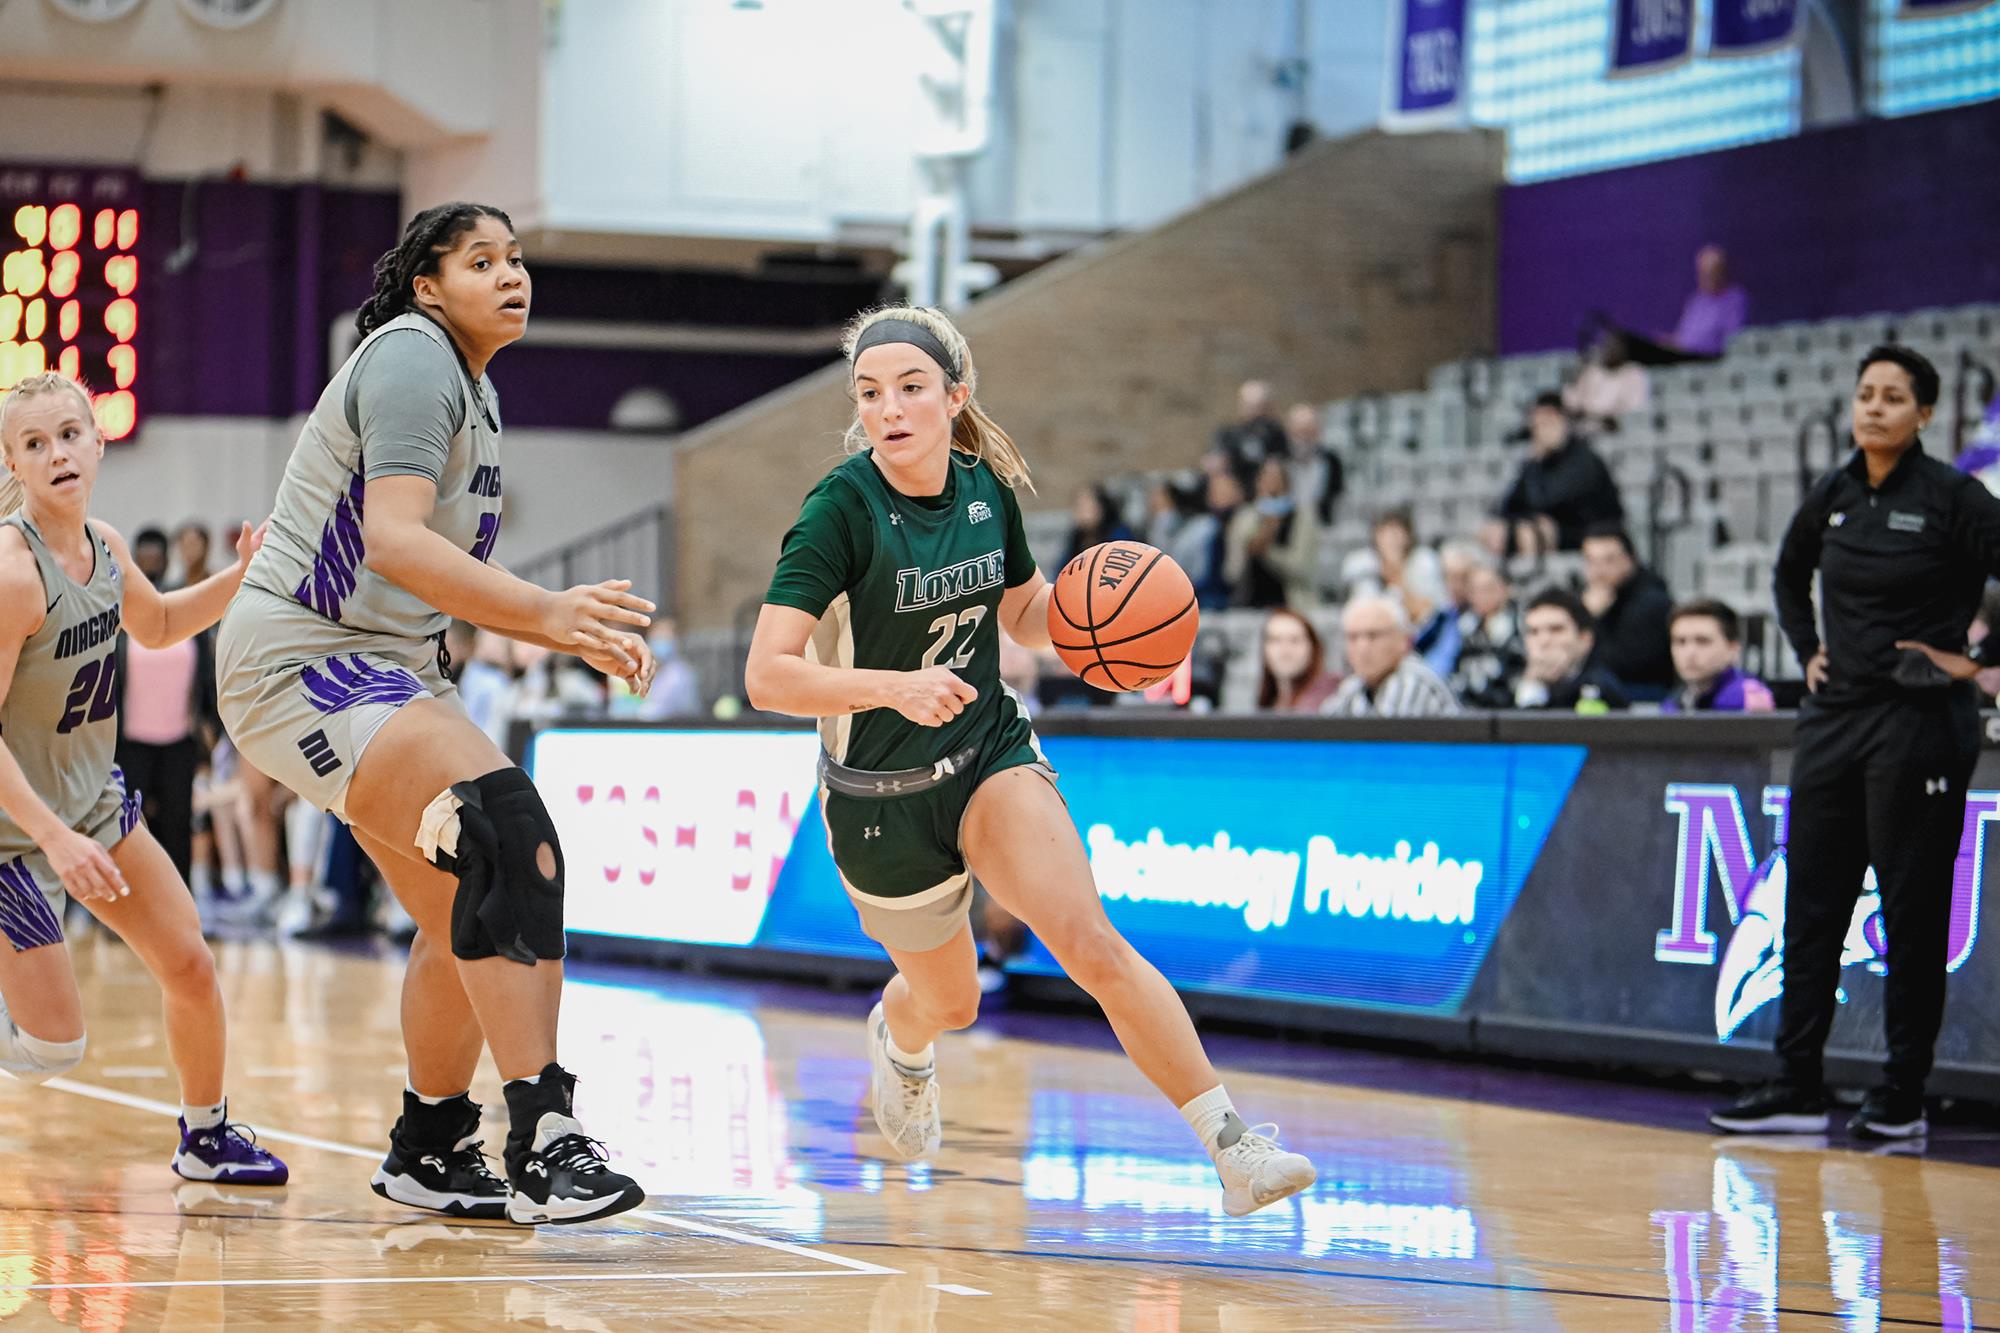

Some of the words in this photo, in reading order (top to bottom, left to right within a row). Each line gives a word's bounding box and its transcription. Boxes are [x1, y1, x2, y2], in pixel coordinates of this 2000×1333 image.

[895, 549, 1005, 613] LOYOLA
[1098, 548, 1144, 591] ROCK
[921, 604, 988, 669] 22
[56, 652, 117, 734] 20
[1304, 836, 1483, 924] Provider
